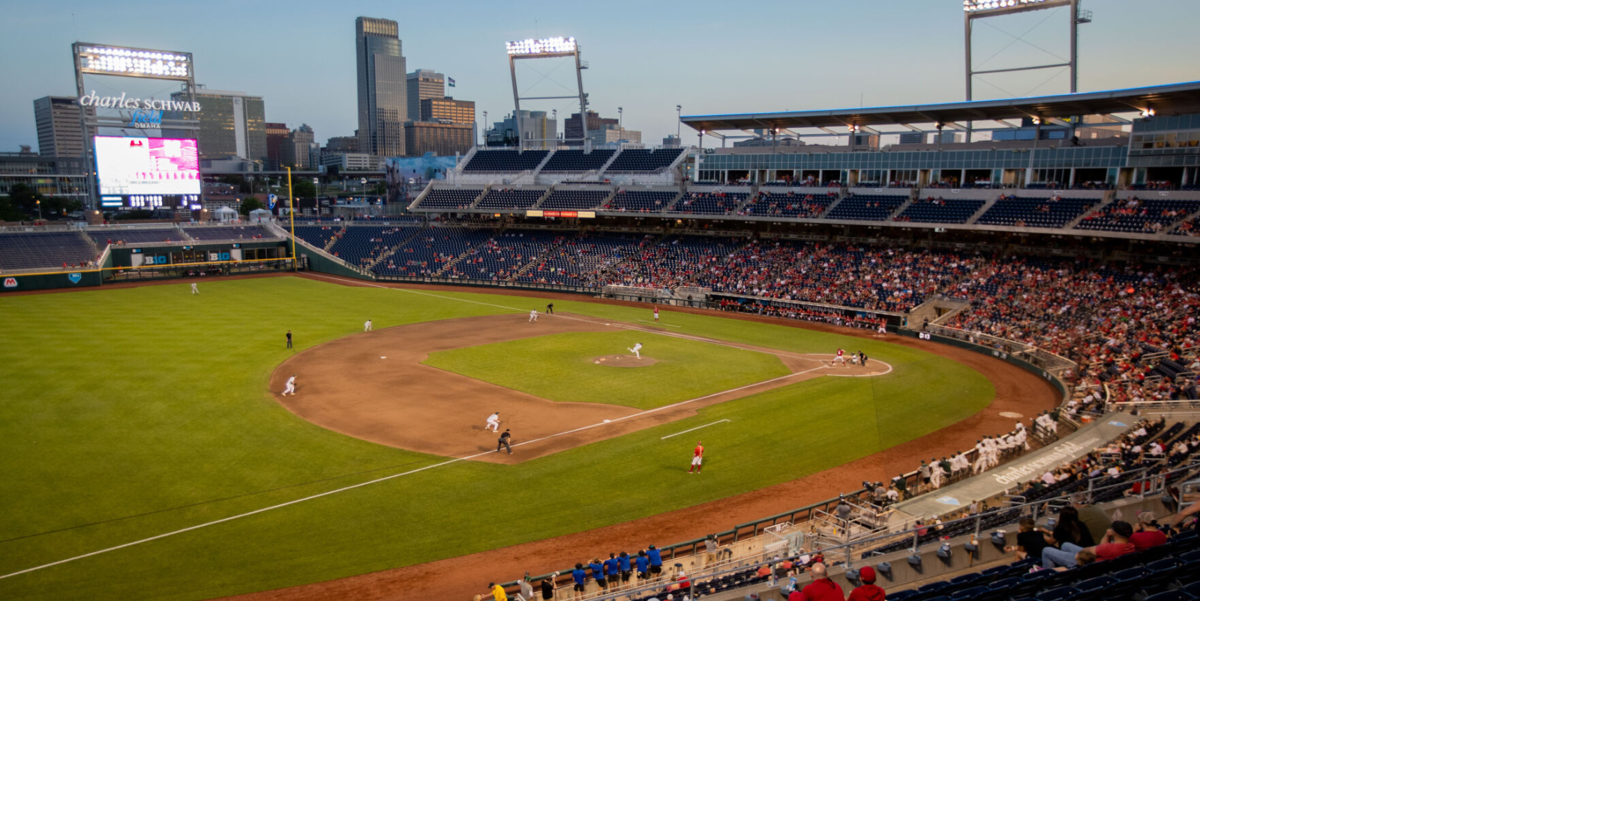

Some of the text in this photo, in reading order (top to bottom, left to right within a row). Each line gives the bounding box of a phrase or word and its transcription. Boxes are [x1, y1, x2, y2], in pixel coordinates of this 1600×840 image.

[80, 90, 201, 112] charles SCHWAB
[128, 109, 164, 127] field
